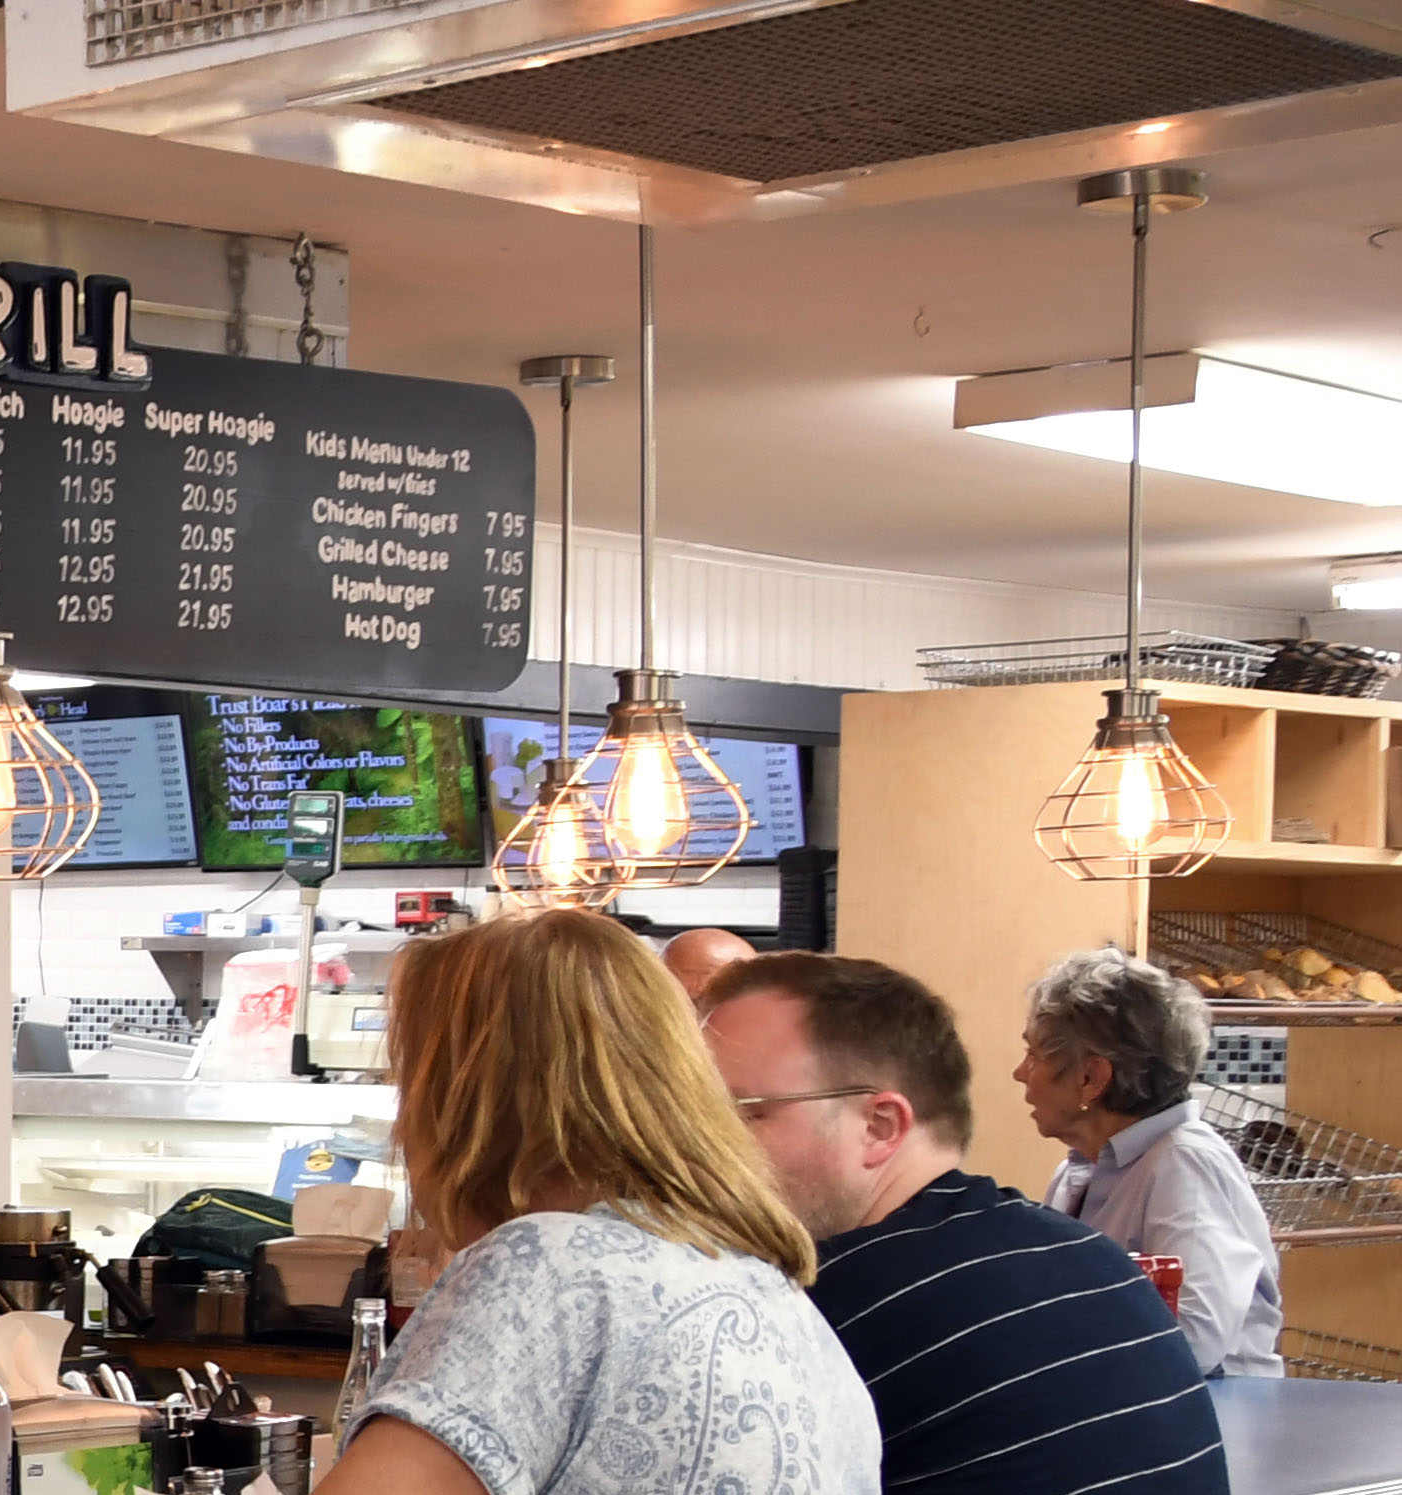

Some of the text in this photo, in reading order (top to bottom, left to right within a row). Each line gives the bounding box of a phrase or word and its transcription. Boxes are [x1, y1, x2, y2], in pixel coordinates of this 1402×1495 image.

[52, 394, 125, 434] Hoagie
[144, 402, 204, 439] Super
[207, 410, 275, 446] Hoagie
[61, 436, 117, 466] 11.95
[183, 445, 238, 477] 20.95
[306, 430, 471, 473] Kids Menu Under 12
[60, 475, 116, 505] 11.95
[181, 483, 238, 515] 20.95
[61, 517, 117, 545] 11.95
[180, 523, 237, 553] 20.95
[312, 496, 459, 538] Chicken Fingers
[58, 553, 116, 584] 12.95
[178, 562, 234, 593] 21.95
[318, 535, 525, 576] Grilled Cheese 7.95
[57, 594, 114, 623] 12.95
[177, 599, 233, 630] 21.95
[332, 573, 525, 613] Hamburger 7.95
[345, 612, 521, 650] Hot Dog 7.95
[205, 695, 249, 715] Trust
[252, 696, 299, 713] Boars
[223, 716, 282, 734] No Fillers
[224, 735, 319, 757] No By-Products
[226, 751, 406, 773] No Artificial Colors or Flavors
[227, 774, 285, 792] No Trans
[229, 795, 251, 811] No
